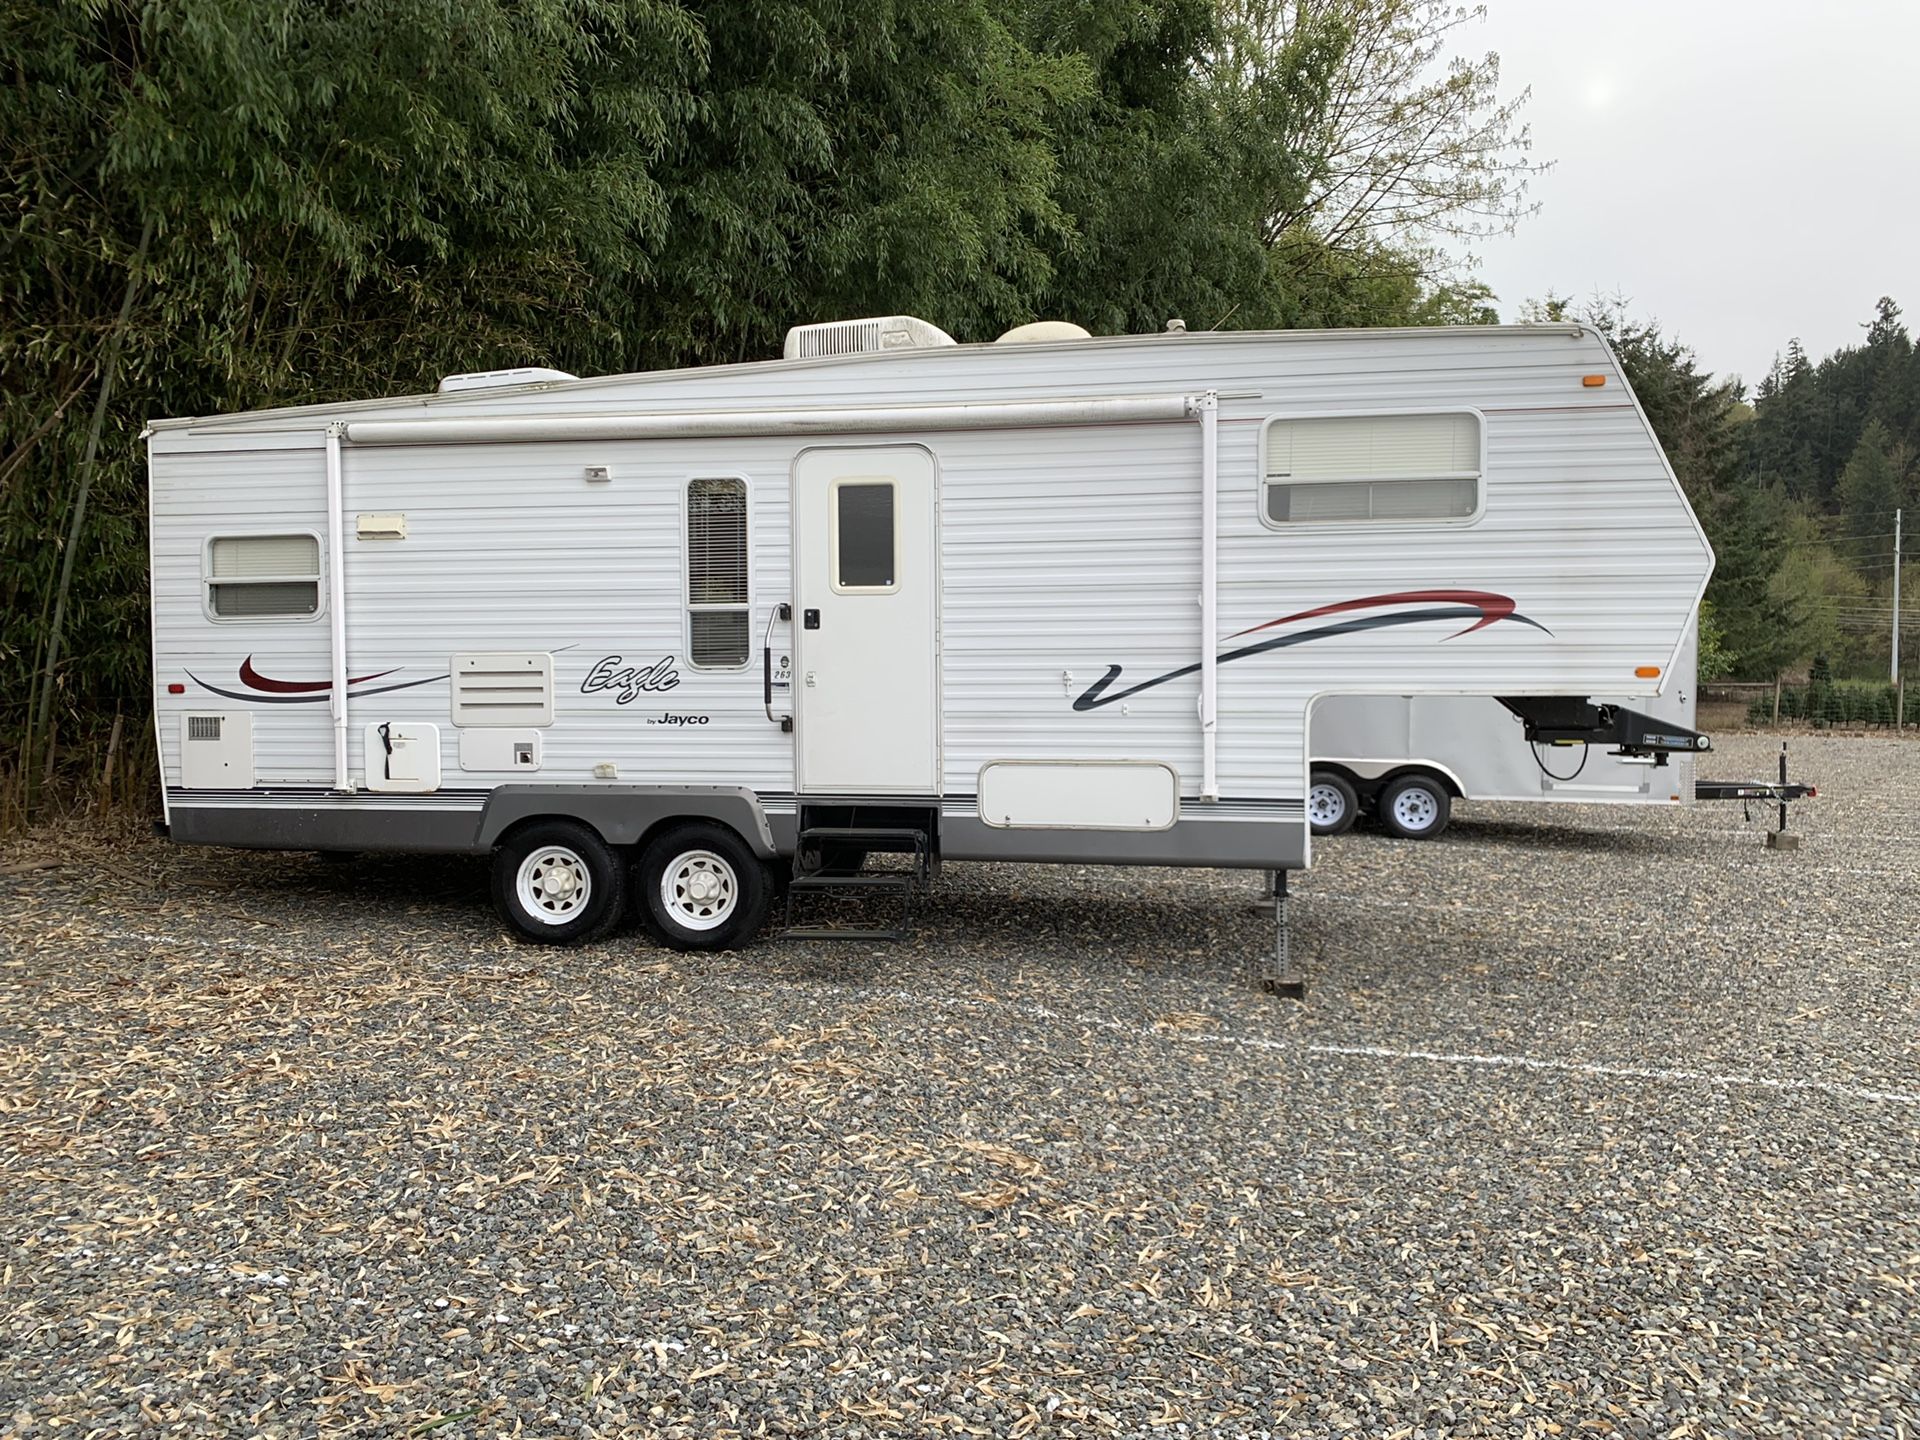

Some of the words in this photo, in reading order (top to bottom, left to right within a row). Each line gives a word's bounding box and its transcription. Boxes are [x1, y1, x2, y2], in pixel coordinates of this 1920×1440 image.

[581, 655, 680, 704] Eagle
[774, 670, 791, 679] 263
[647, 718, 657, 726] by
[658, 713, 709, 727] Jayco
